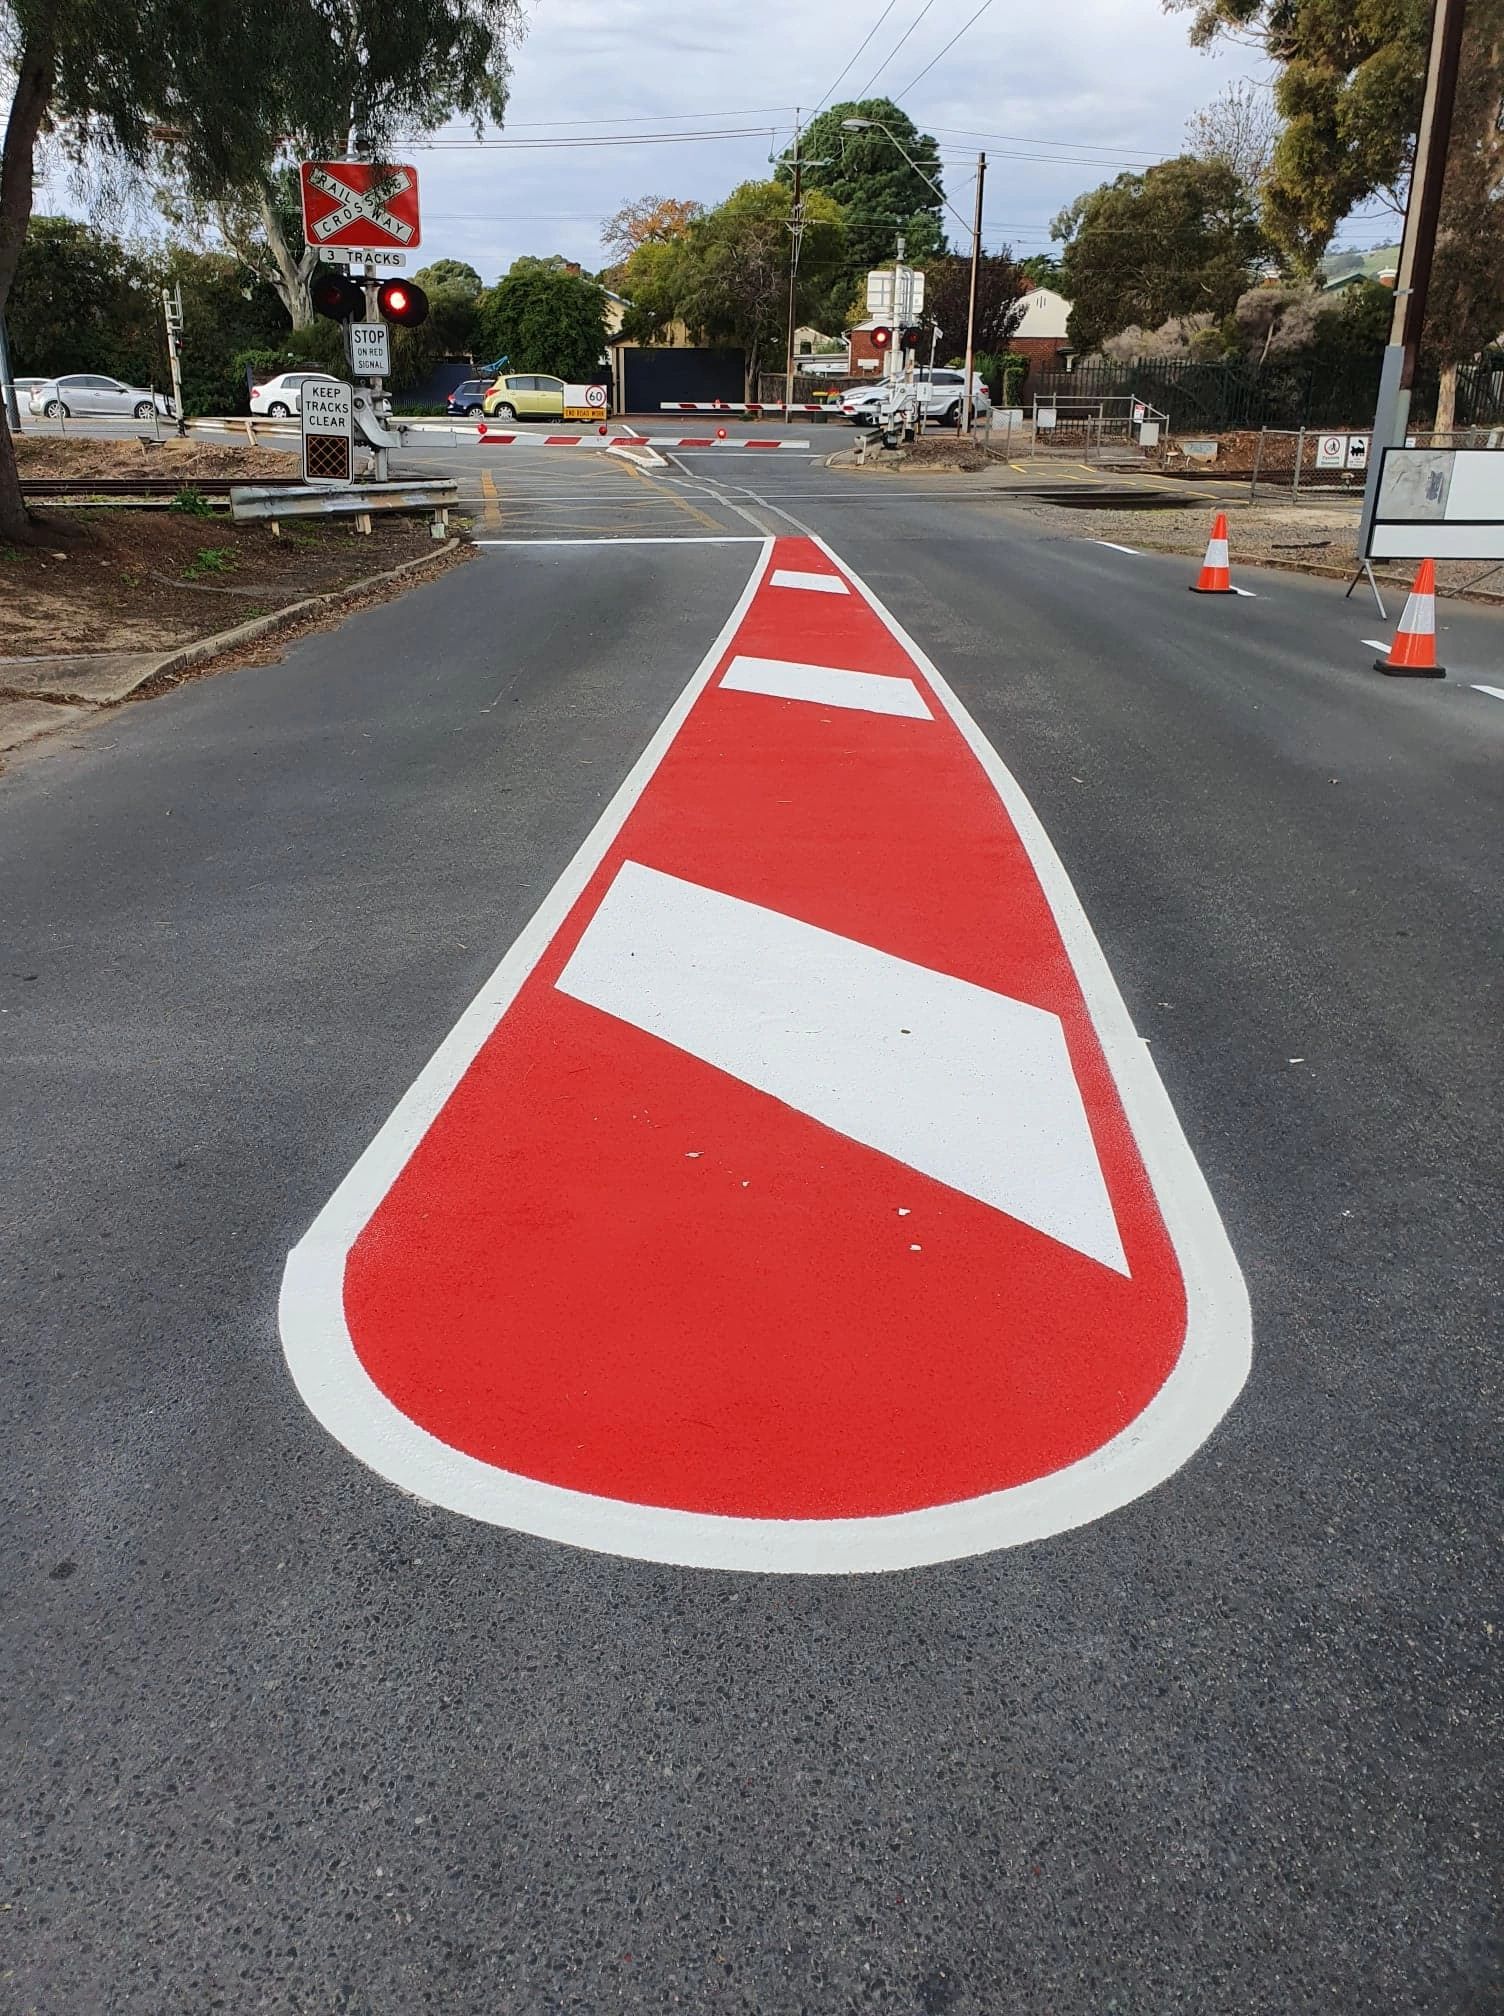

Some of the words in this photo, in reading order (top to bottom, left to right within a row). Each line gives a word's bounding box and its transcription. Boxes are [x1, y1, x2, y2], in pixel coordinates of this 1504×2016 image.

[319, 174, 404, 235] RAILWAY
[327, 250, 335, 260] 3
[347, 251, 400, 265] TRACKS
[354, 329, 385, 344] STOP
[357, 348, 367, 357] ON
[369, 348, 383, 357] RED
[358, 360, 384, 369] SIGNAL
[312, 386, 341, 398] KEEP
[589, 391, 603, 401] 60
[306, 401, 349, 413] TRACKS
[309, 416, 345, 428] CLEAR
